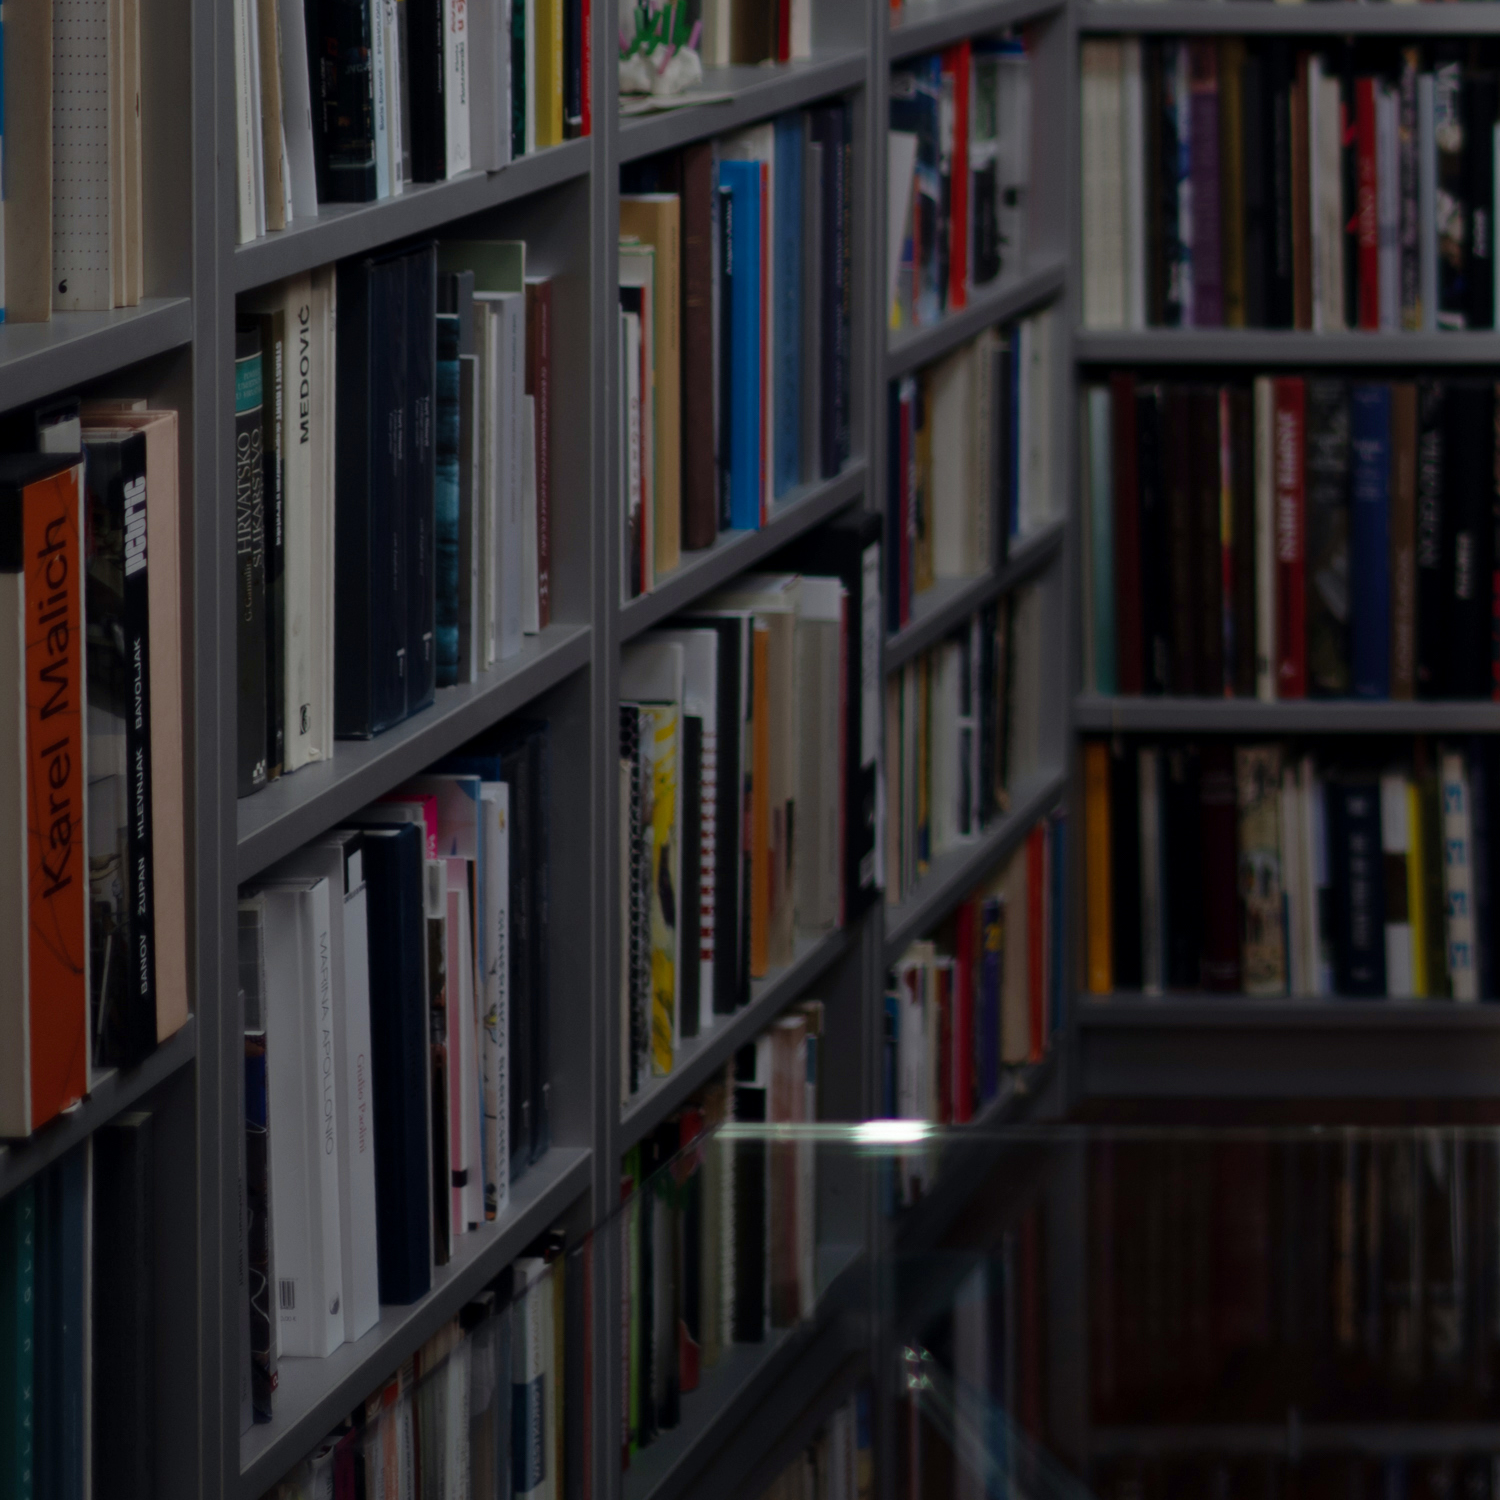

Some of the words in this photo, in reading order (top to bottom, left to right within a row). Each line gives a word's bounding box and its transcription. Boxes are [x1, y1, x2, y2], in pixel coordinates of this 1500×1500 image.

[297, 304, 309, 444] MEDOVIĆ
[237, 432, 252, 553] HRVATSKO
[250, 428, 263, 567] SLIKARSTVO
[37, 516, 70, 721] Malich
[132, 638, 143, 729] BAVOLJAK
[41, 737, 73, 899] Karel
[134, 747, 145, 839] HLEVNJAK
[136, 857, 147, 916] ŽUPAN
[139, 934, 149, 995] BANOV
[319, 932, 329, 1020] MARINA
[321, 1029, 334, 1155] APOLLONIO
[357, 1054, 366, 1100] Giulio
[358, 1103, 367, 1153] Paolini
